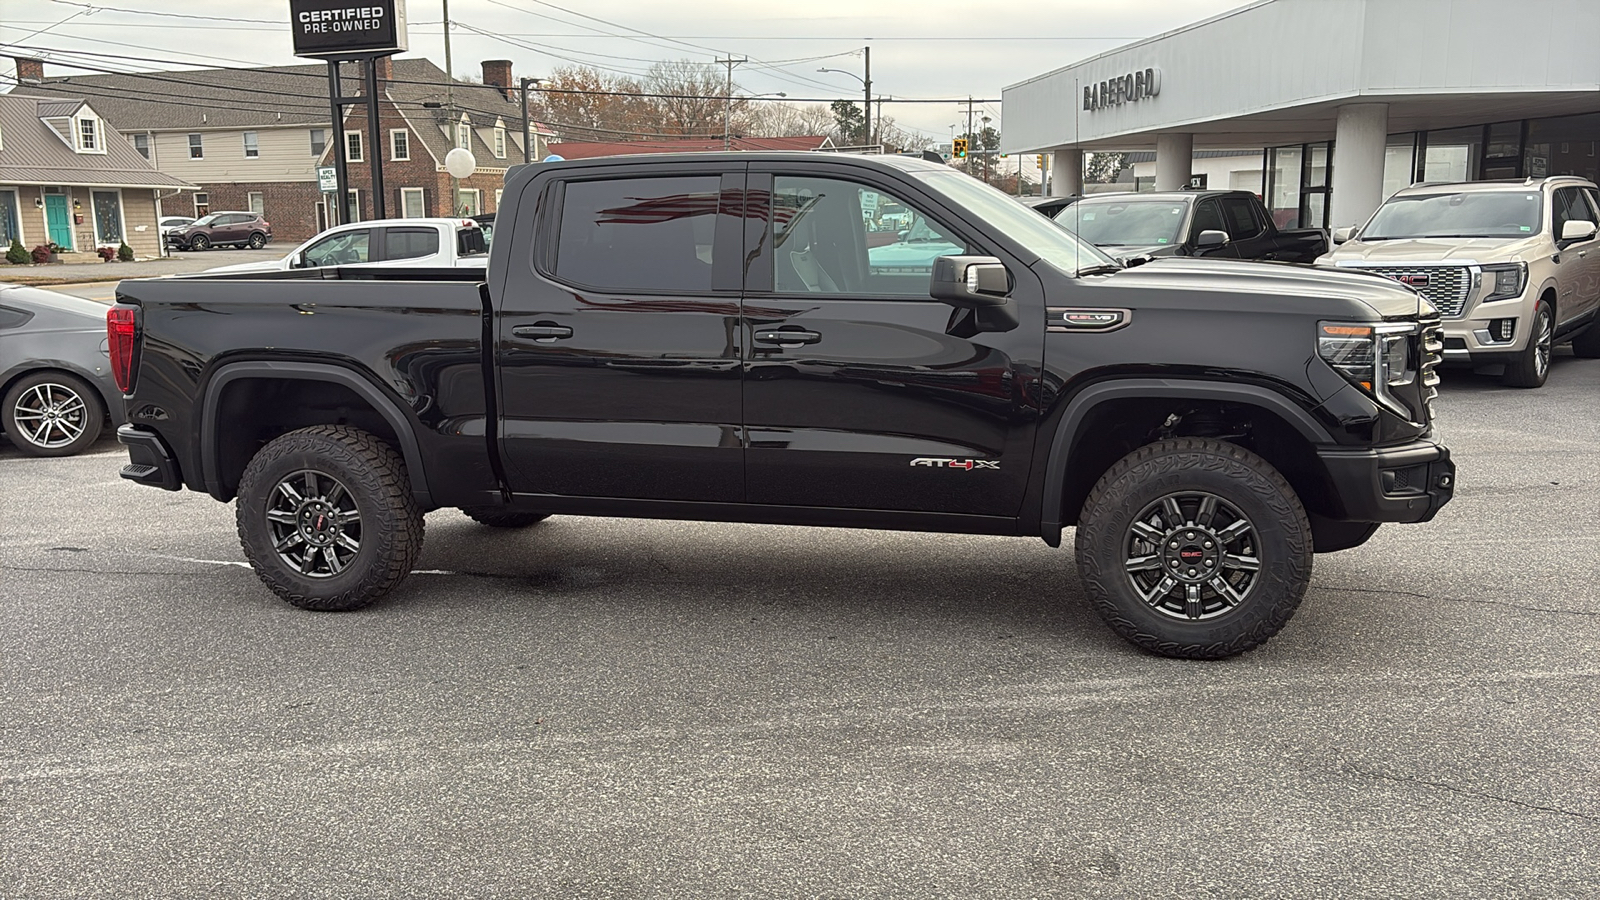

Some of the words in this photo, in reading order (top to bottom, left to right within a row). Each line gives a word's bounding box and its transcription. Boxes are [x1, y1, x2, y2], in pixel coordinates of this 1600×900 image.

[299, 6, 384, 23] CERTIFIED
[304, 19, 380, 34] PRE-OWNED
[1083, 68, 1160, 111] BAREFORD
[1389, 275, 1428, 286] MC
[909, 457, 1001, 472] AT4X
